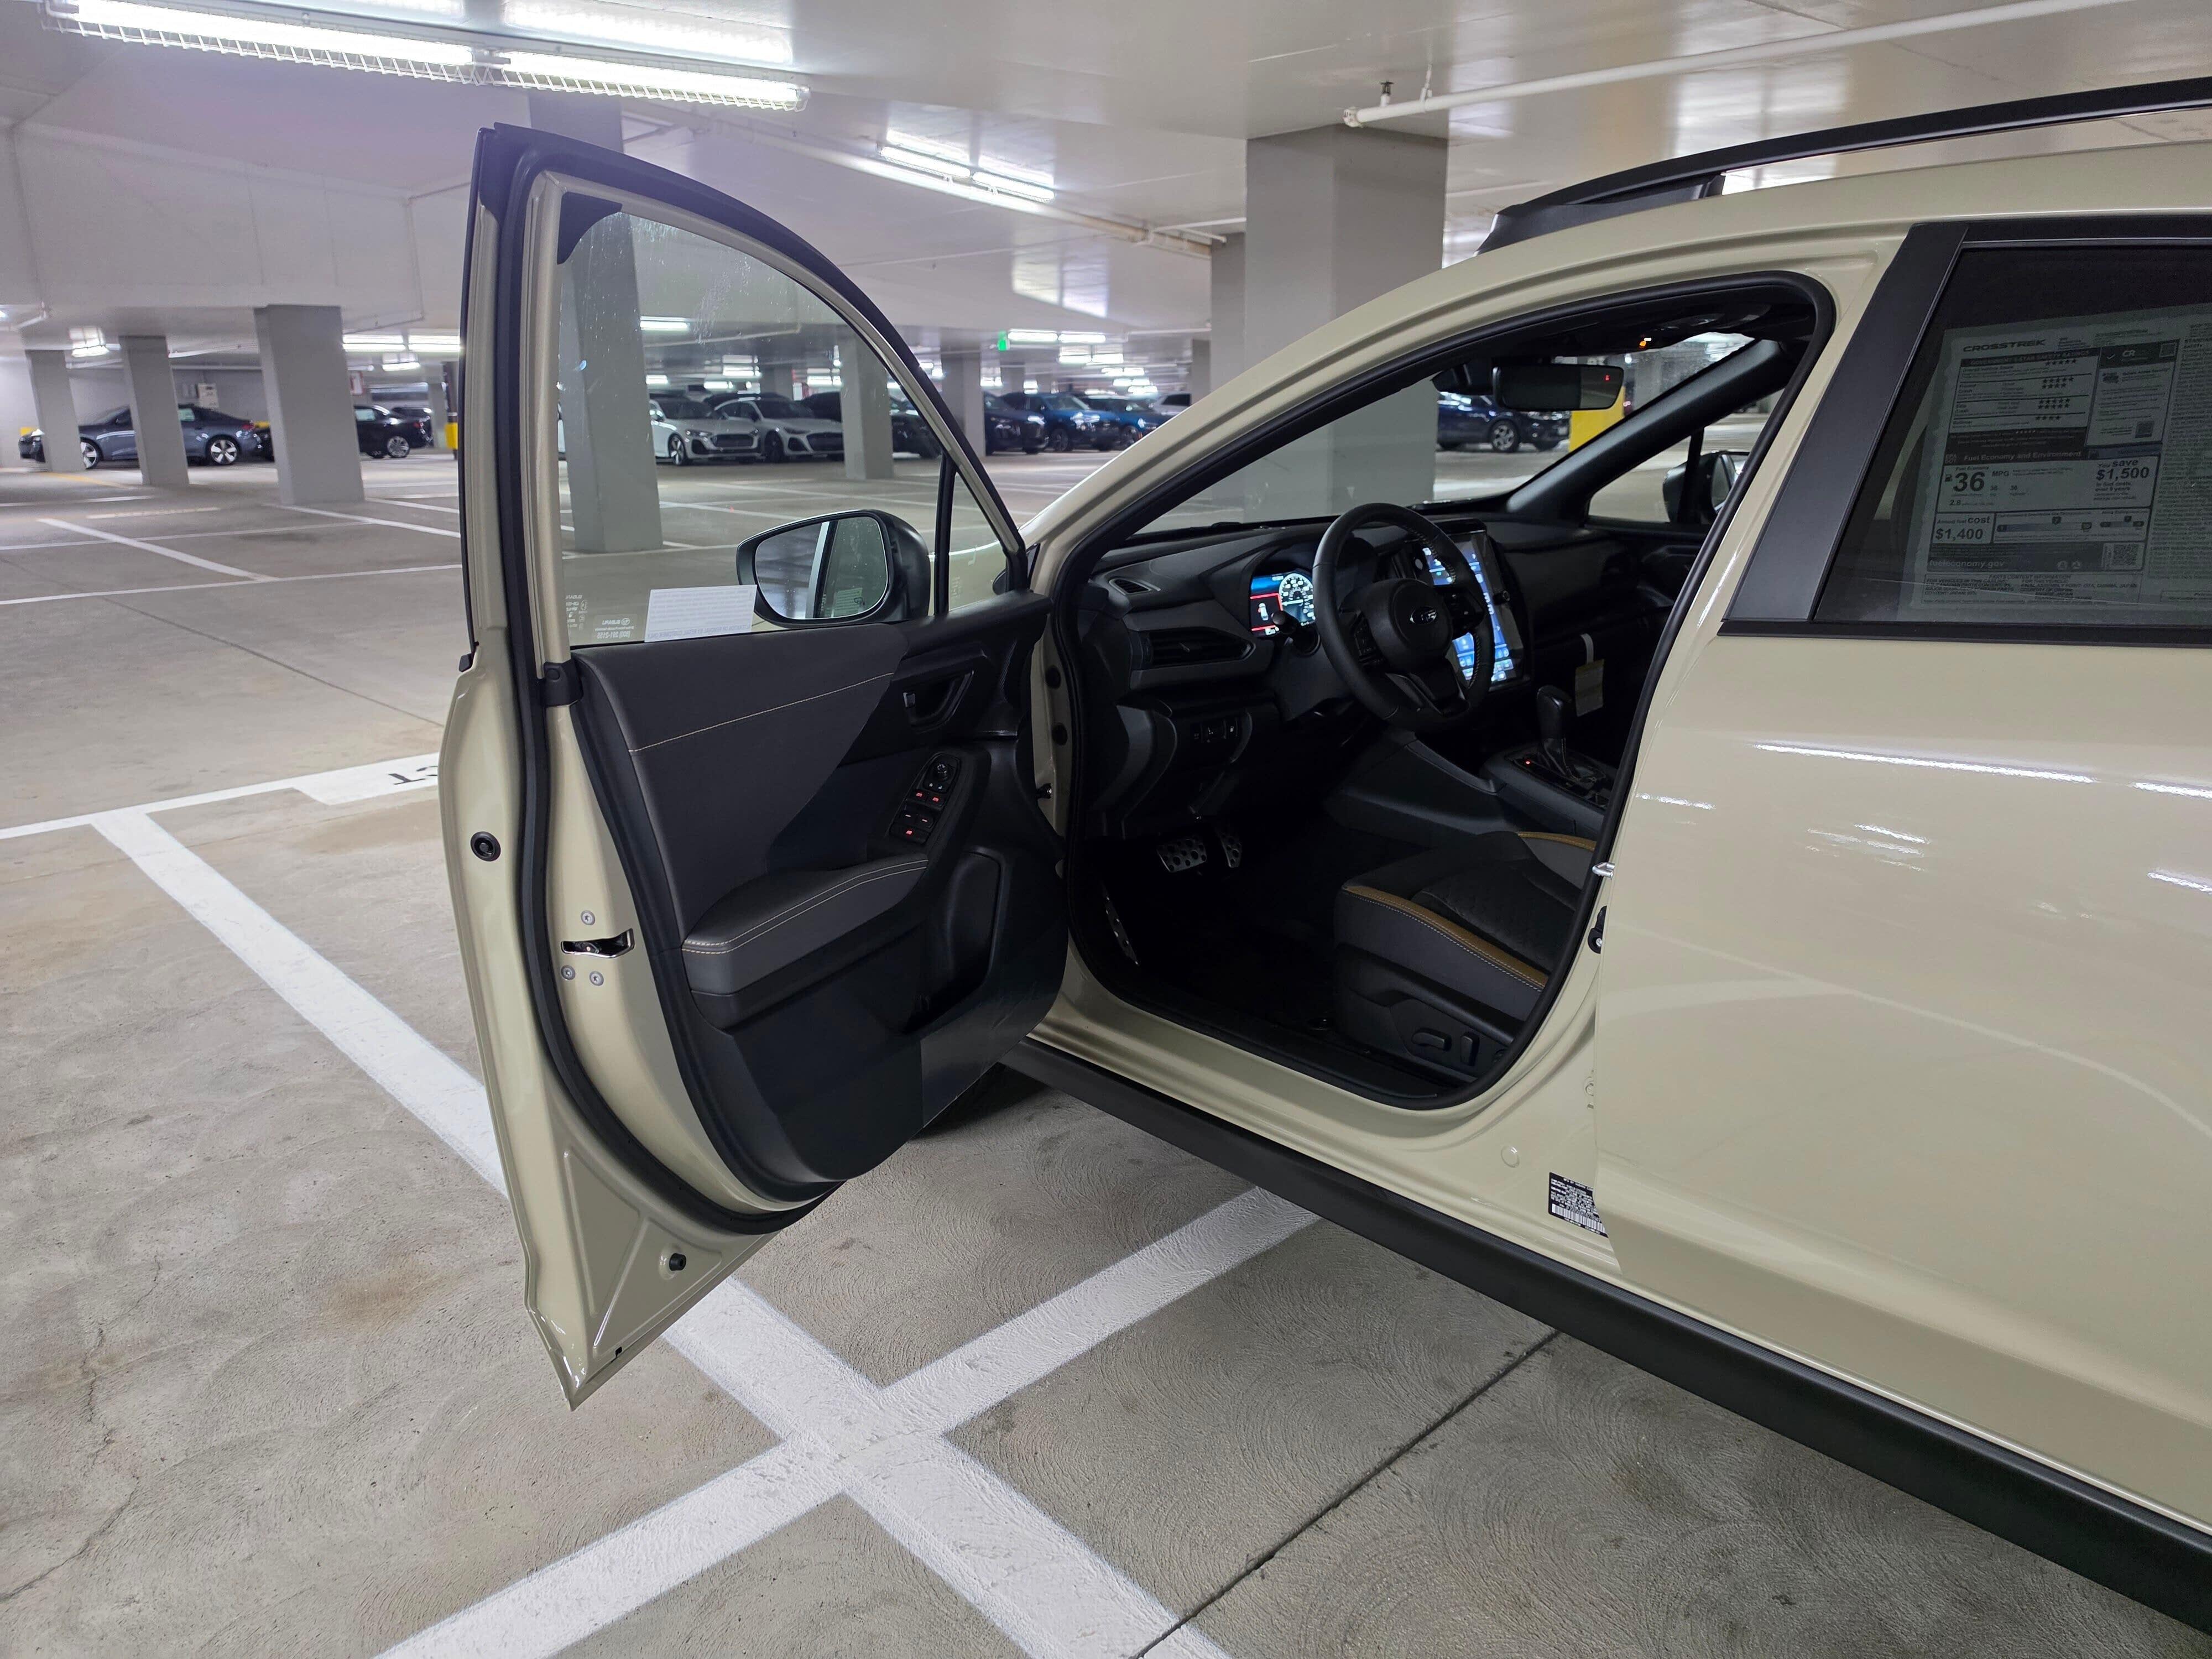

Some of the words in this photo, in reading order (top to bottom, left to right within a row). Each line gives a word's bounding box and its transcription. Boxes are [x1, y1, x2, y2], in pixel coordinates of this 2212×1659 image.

[1963, 339, 2046, 352] CROSSTREK
[2032, 451, 2081, 459] Environment
[2111, 459, 2139, 468] save
[2095, 466, 2150, 481] $1,500
[1953, 471, 1986, 492] 36
[1967, 515, 1990, 524] cost
[1934, 527, 1984, 541] $1,400
[1929, 559, 2005, 568] fueleconomy.gov
